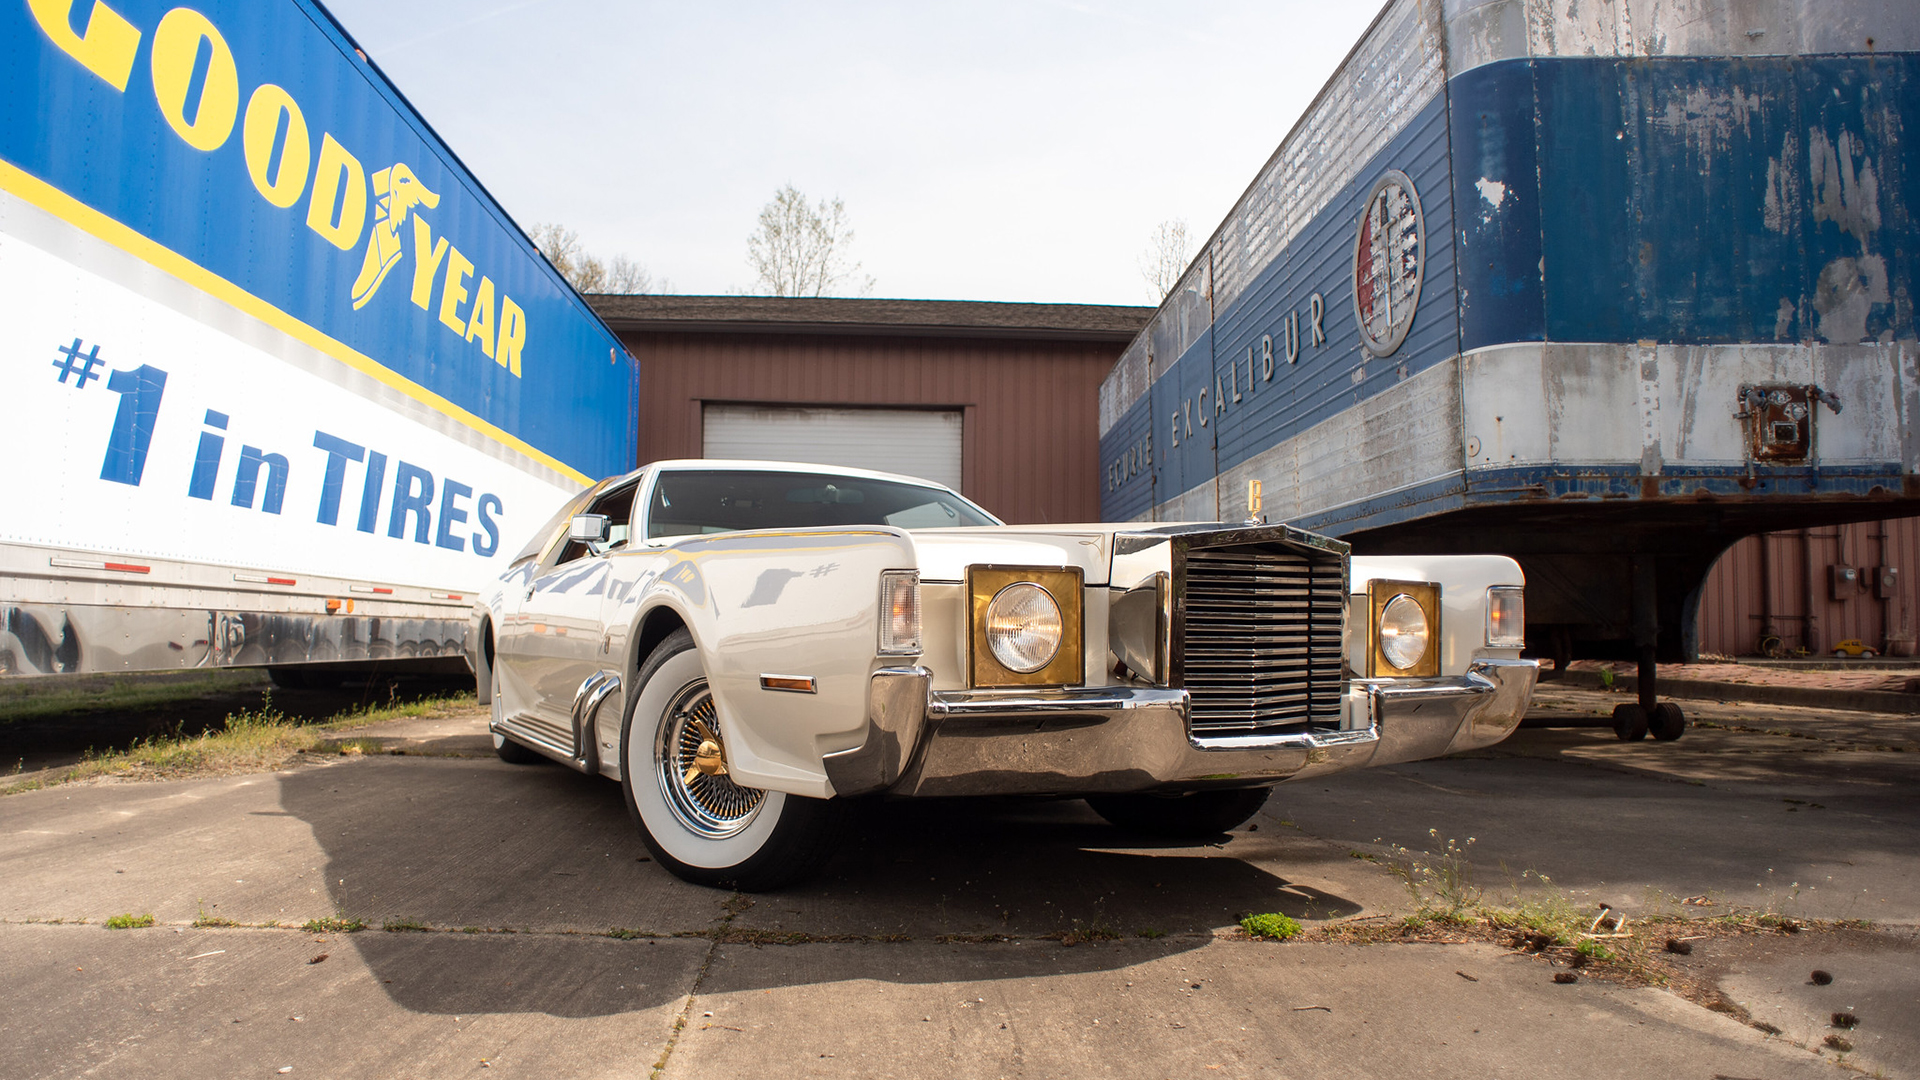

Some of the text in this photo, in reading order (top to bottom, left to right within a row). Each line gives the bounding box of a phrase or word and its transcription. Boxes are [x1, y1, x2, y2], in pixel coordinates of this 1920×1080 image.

[1109, 292, 1326, 492] ECURIE EXCALIBUR
[188, 409, 290, 515] in
[314, 430, 504, 558] TIRES
